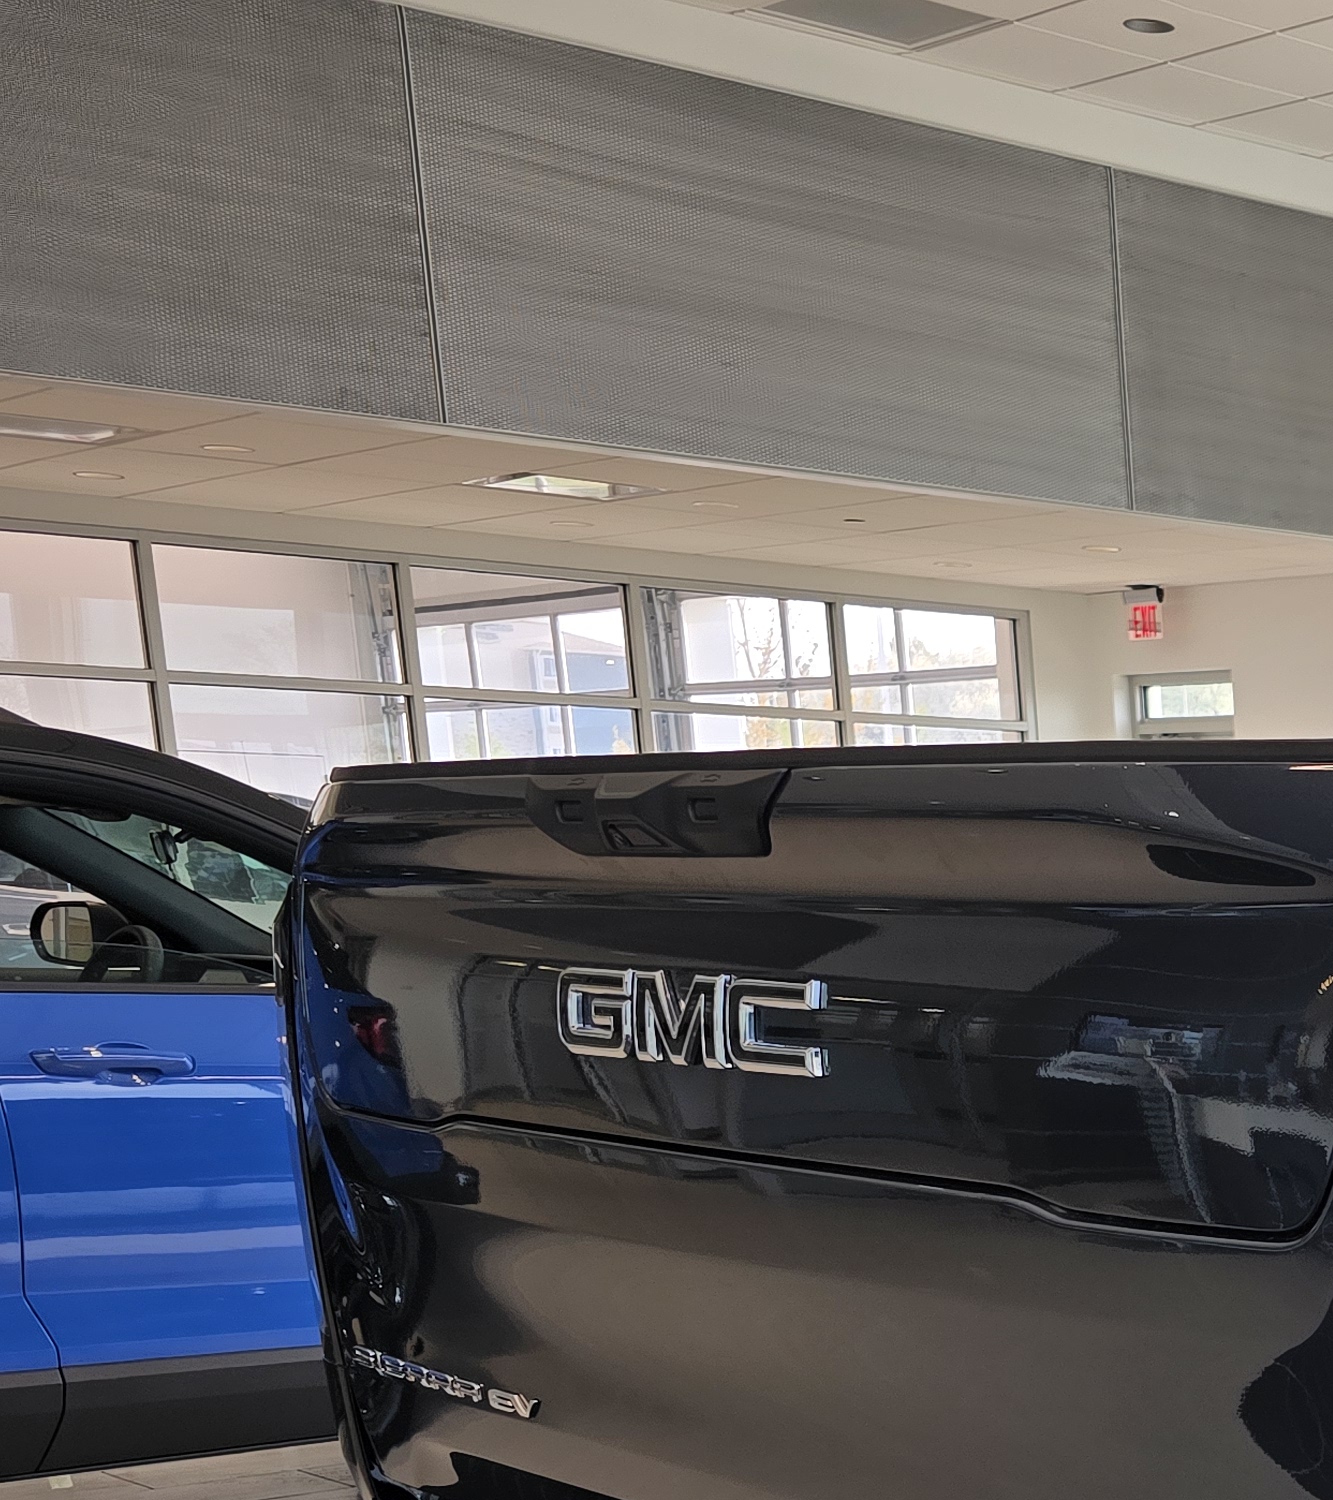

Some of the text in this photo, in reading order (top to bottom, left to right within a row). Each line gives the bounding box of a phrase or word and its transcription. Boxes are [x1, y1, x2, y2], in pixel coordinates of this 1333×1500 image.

[1133, 604, 1157, 638] EXIT
[557, 967, 830, 1078] GMC
[487, 1387, 542, 1419] EV
